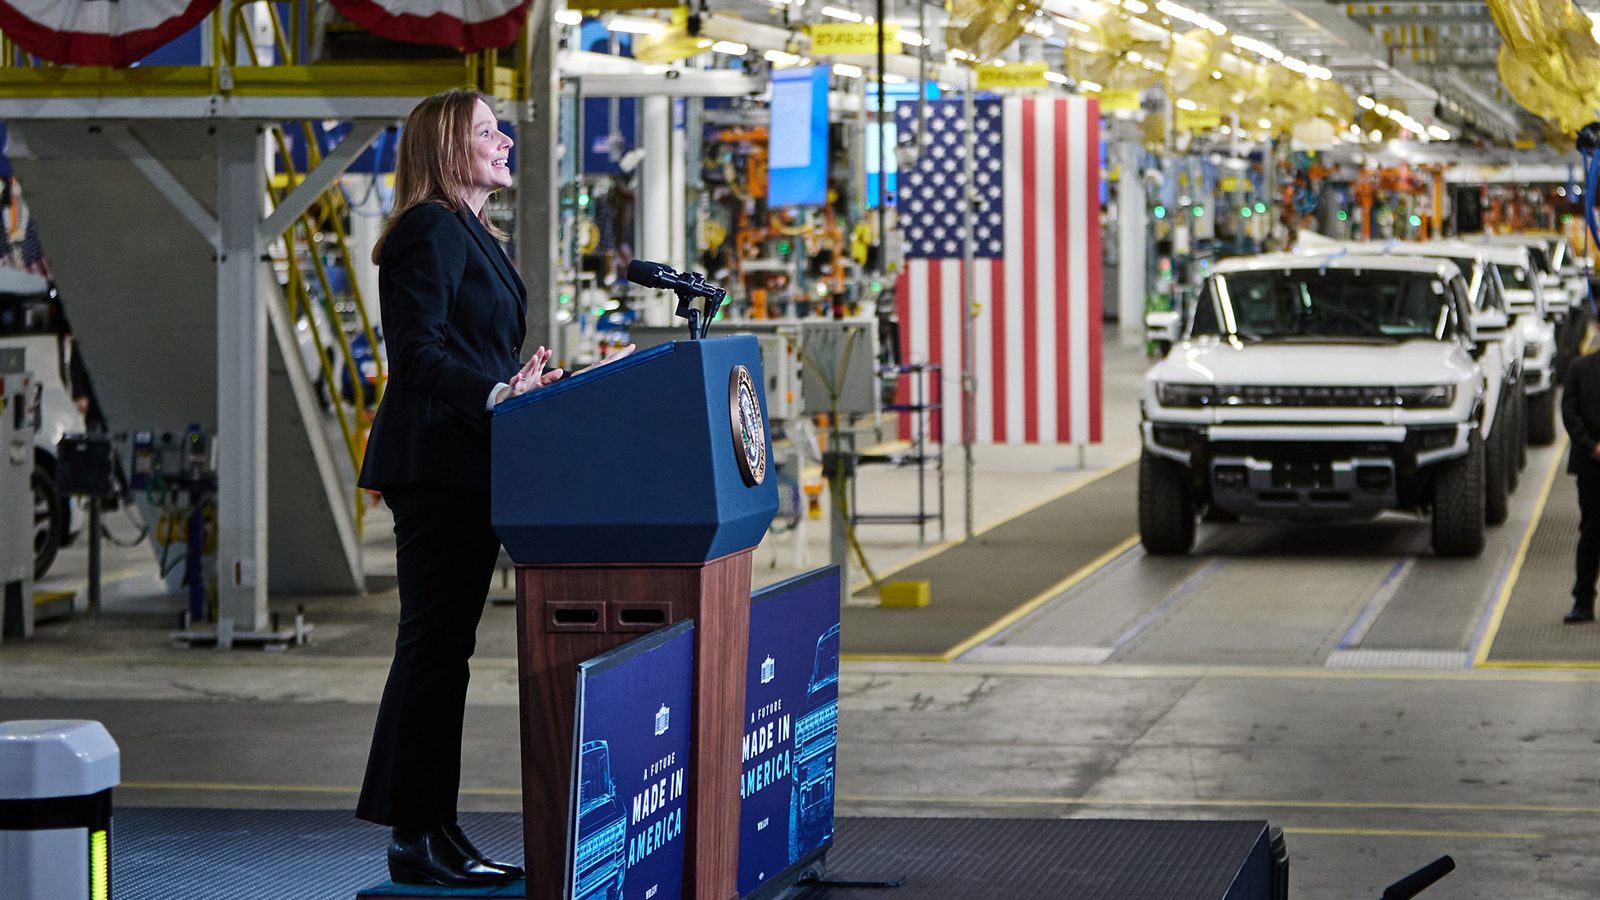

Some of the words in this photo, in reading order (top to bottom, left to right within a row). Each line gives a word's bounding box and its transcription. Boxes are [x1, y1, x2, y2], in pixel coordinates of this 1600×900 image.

[751, 712, 755, 724] A
[757, 699, 782, 720] FUTURE
[742, 721, 774, 763] MADE
[778, 713, 790, 744] IN
[643, 768, 648, 781] A
[650, 752, 676, 777] FUTURE
[740, 749, 791, 800] AMERICA
[632, 777, 667, 826] MADE
[670, 767, 684, 801] IN
[627, 807, 682, 869] AMERICA
